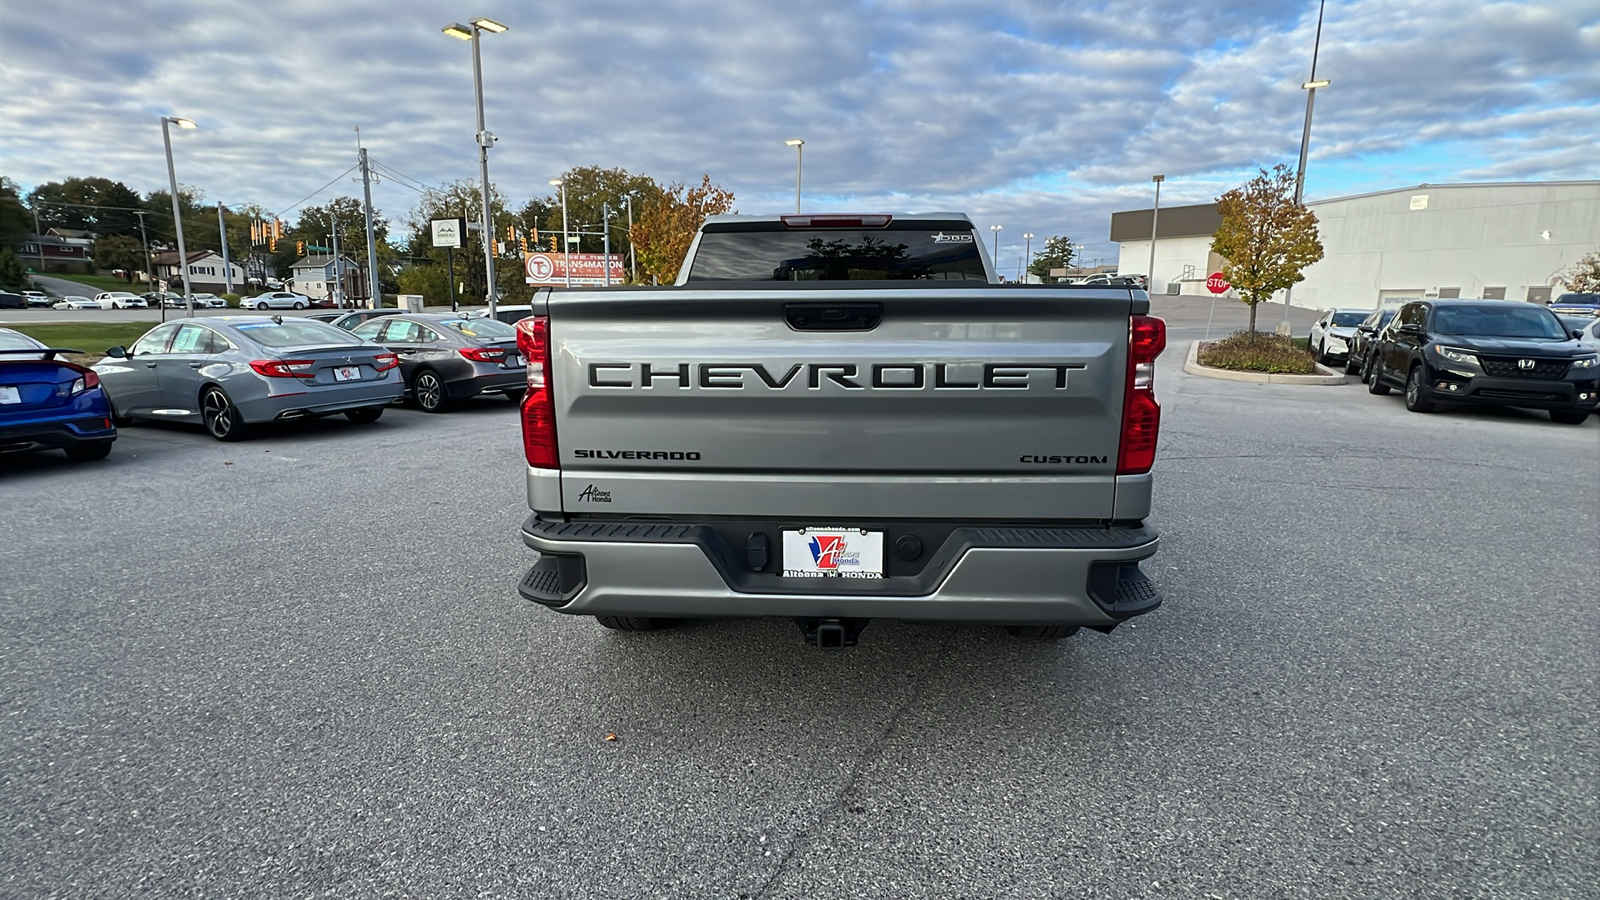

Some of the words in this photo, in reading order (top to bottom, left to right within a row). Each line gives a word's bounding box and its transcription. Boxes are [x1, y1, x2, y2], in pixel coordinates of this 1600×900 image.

[554, 260, 623, 269] TRNS4MATON
[1207, 278, 1230, 288] STOP
[588, 363, 1087, 390] CHEVROLET
[574, 449, 701, 461] SILVERADO
[1020, 455, 1108, 464] CUSTOM
[834, 556, 860, 565] Honda
[782, 570, 824, 578] Altoona
[841, 571, 883, 579] HONDA
